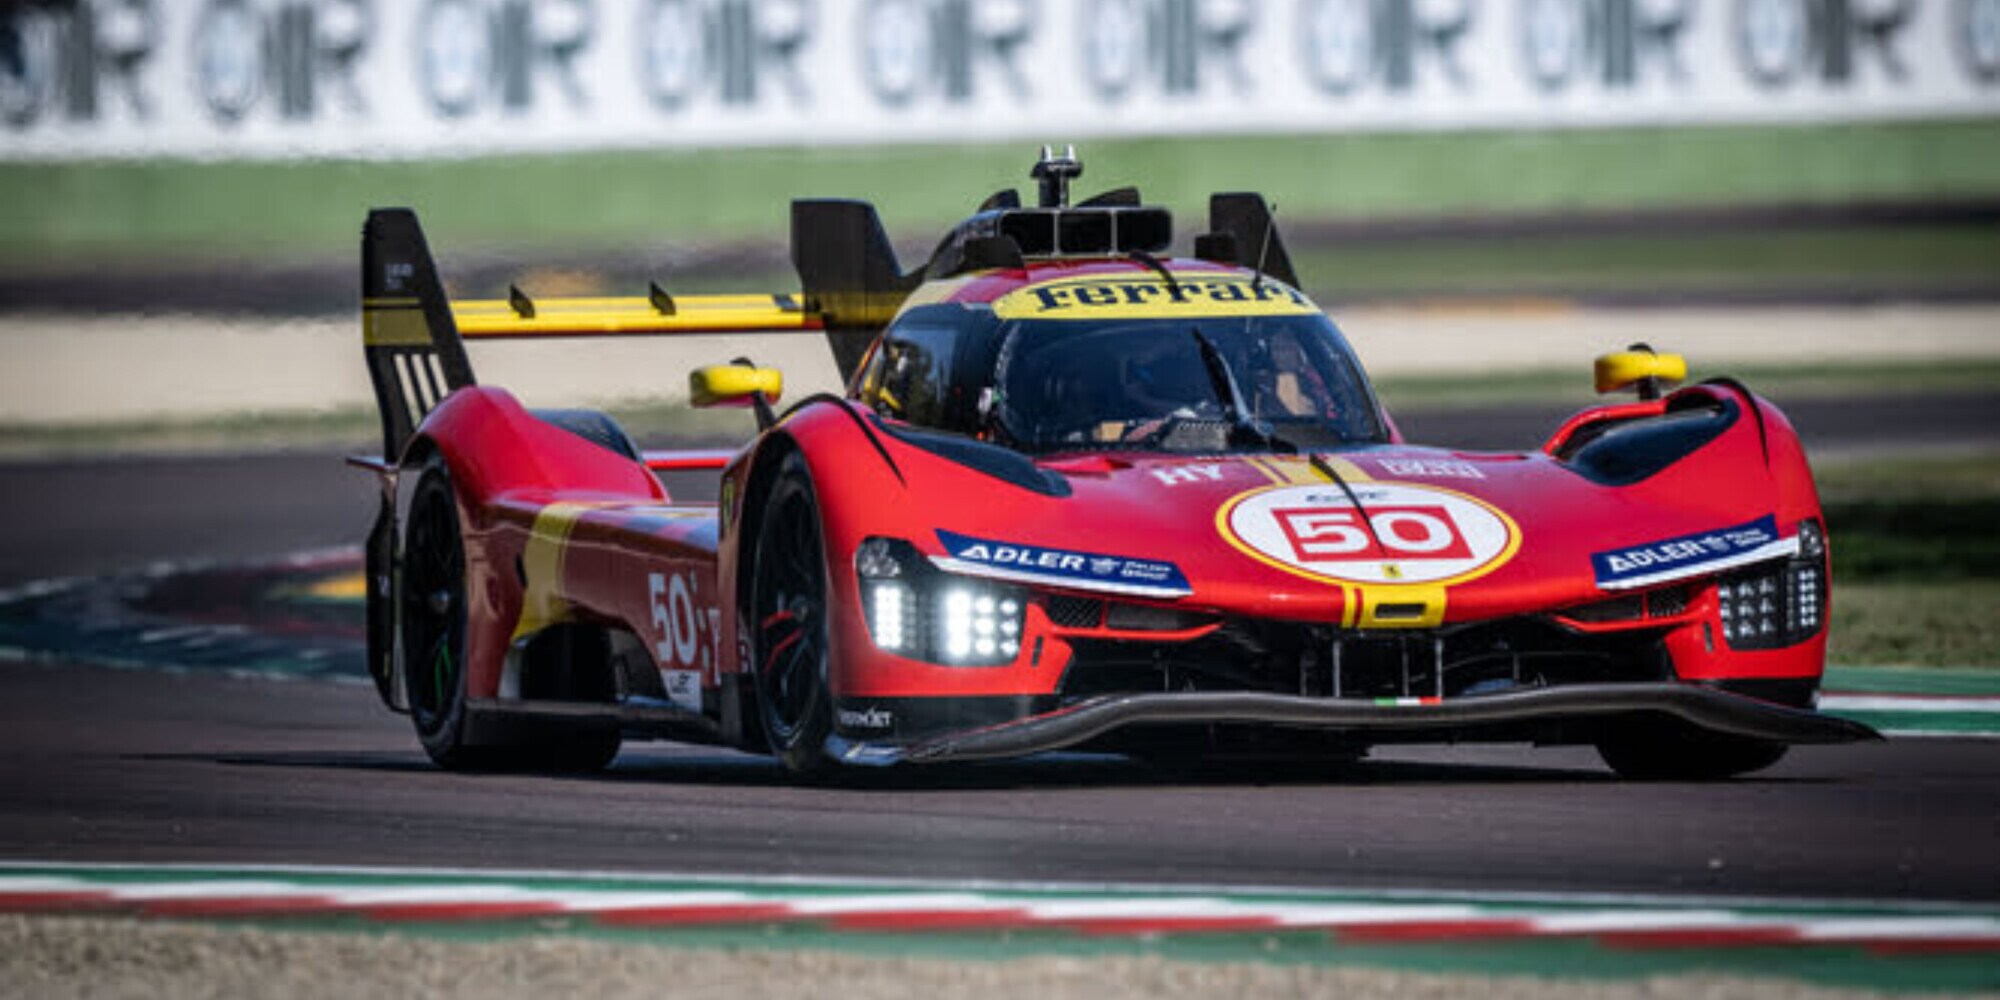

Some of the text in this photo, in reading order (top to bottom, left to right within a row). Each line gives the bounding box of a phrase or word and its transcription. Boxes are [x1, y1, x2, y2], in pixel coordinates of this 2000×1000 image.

[1026, 282, 1310, 312] Ferrari
[1285, 511, 1455, 554] 50
[959, 544, 1085, 570] ADLER
[1607, 537, 1708, 573] ADLER
[648, 573, 697, 665] 50
